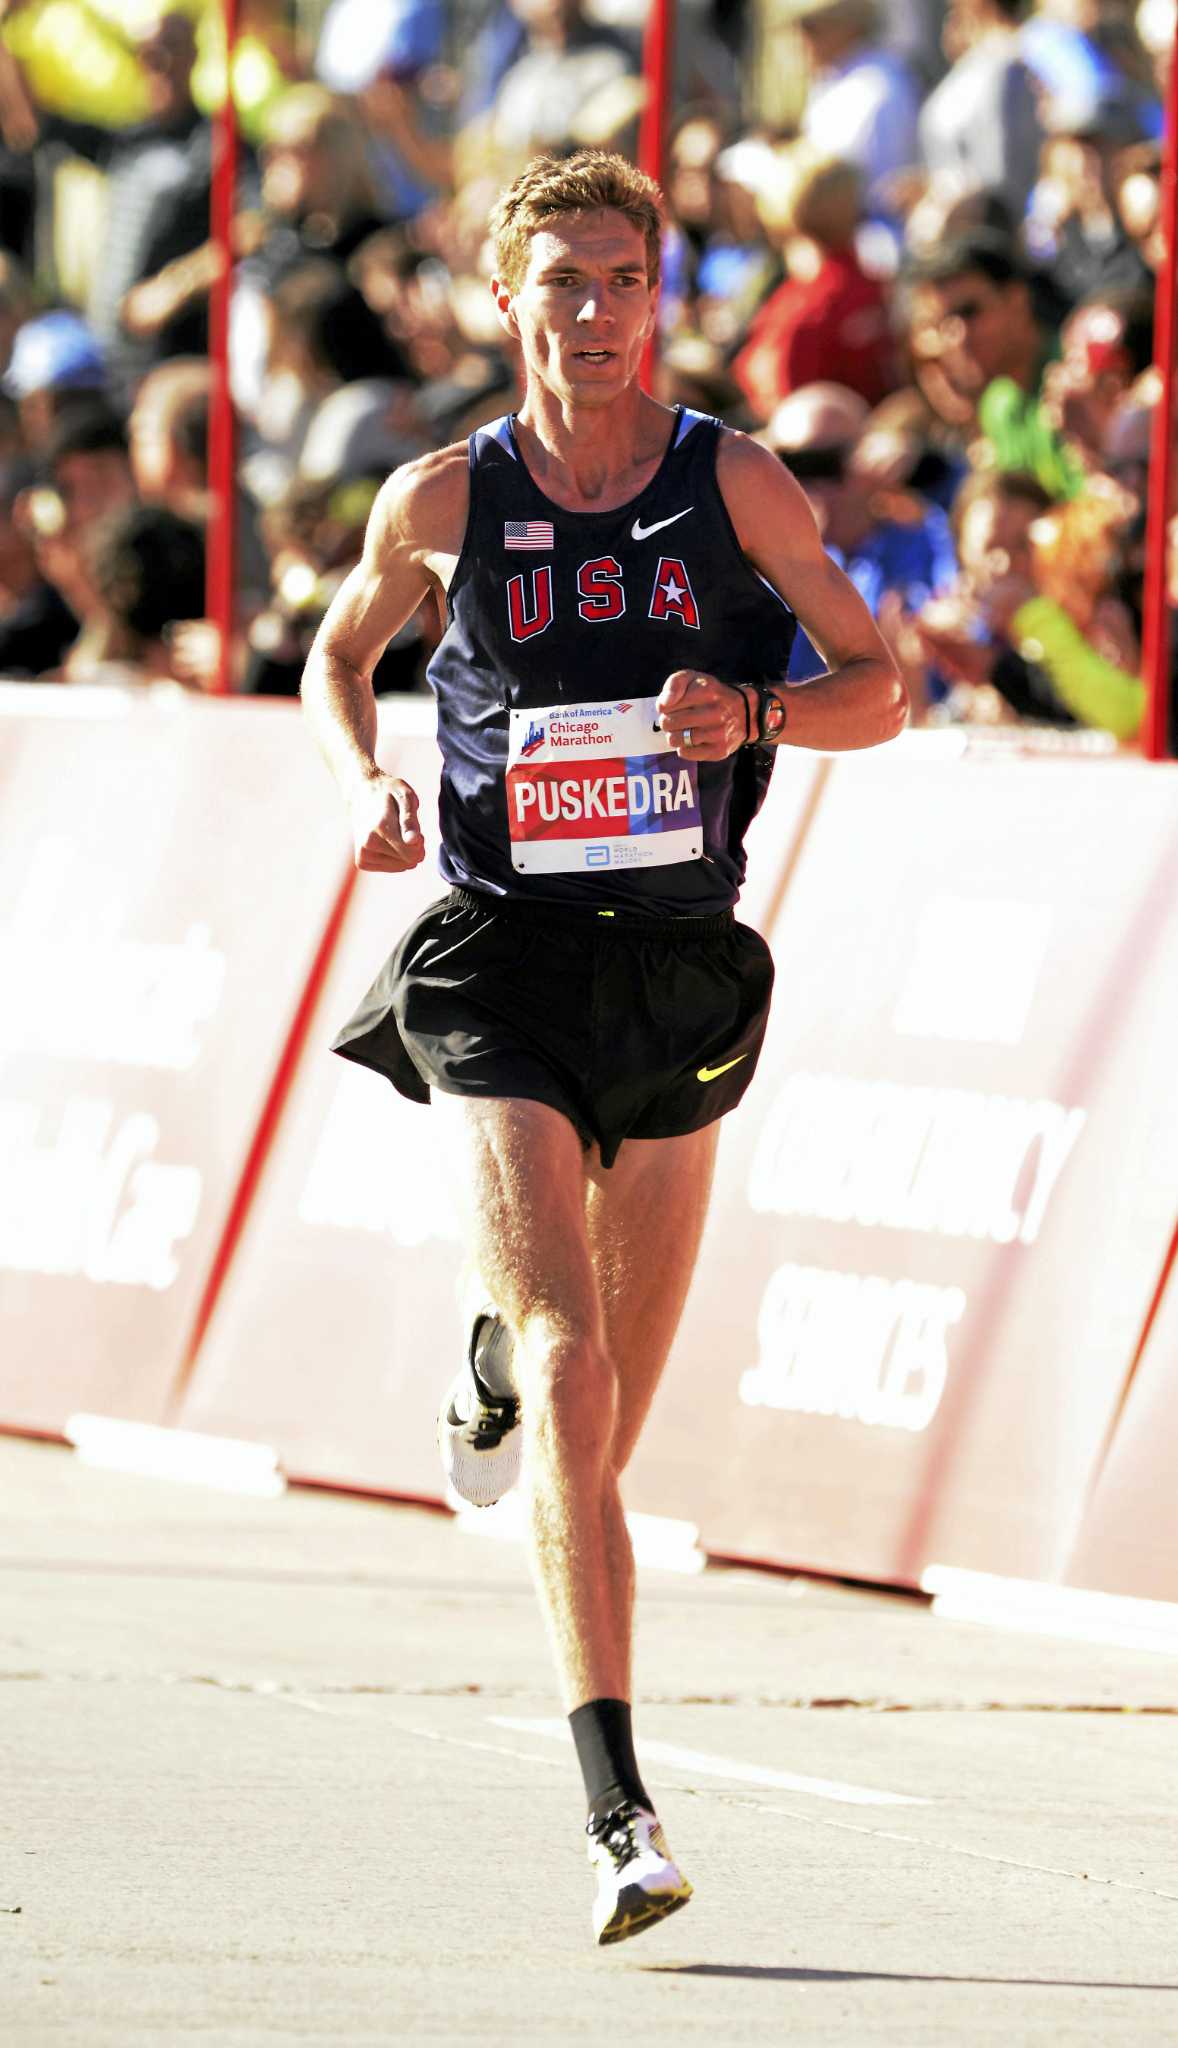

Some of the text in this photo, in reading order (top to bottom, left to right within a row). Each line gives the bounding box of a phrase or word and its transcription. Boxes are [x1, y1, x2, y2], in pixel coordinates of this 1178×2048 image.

[506, 556, 700, 643] USA
[570, 709, 578, 717] of
[580, 707, 612, 717] America
[550, 722, 599, 734] Chicago
[550, 734, 612, 747] Marathon
[514, 769, 695, 823] PUSKEDRA
